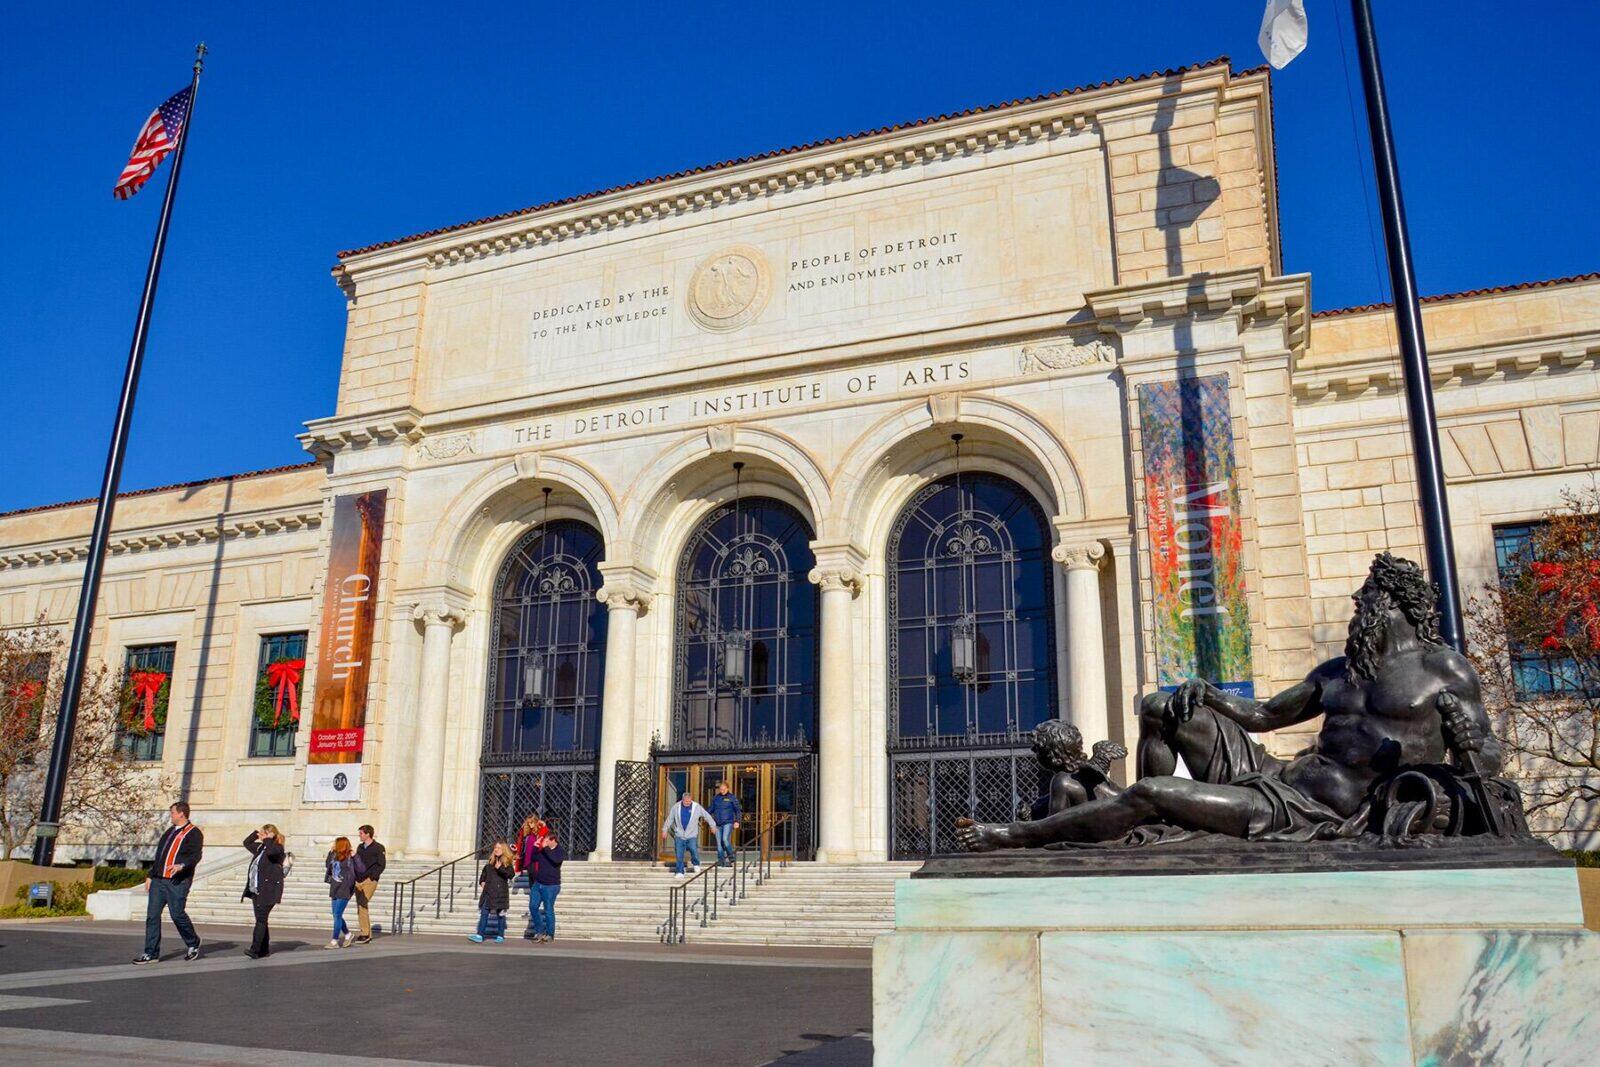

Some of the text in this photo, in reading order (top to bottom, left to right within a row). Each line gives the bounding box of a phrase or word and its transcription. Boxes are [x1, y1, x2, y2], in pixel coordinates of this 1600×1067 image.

[532, 254, 963, 340] TO THE KNOWLEDGE AND ENJOYMENT OF ART
[533, 232, 958, 320] DEDICATED BY THE PEOPLE OF DETROIT
[514, 362, 969, 443] THE DETROIT INSTITUTE OF ARTS
[1156, 486, 1168, 531] FRAMING
[1171, 480, 1230, 623] Monet
[332, 574, 371, 680] Church
